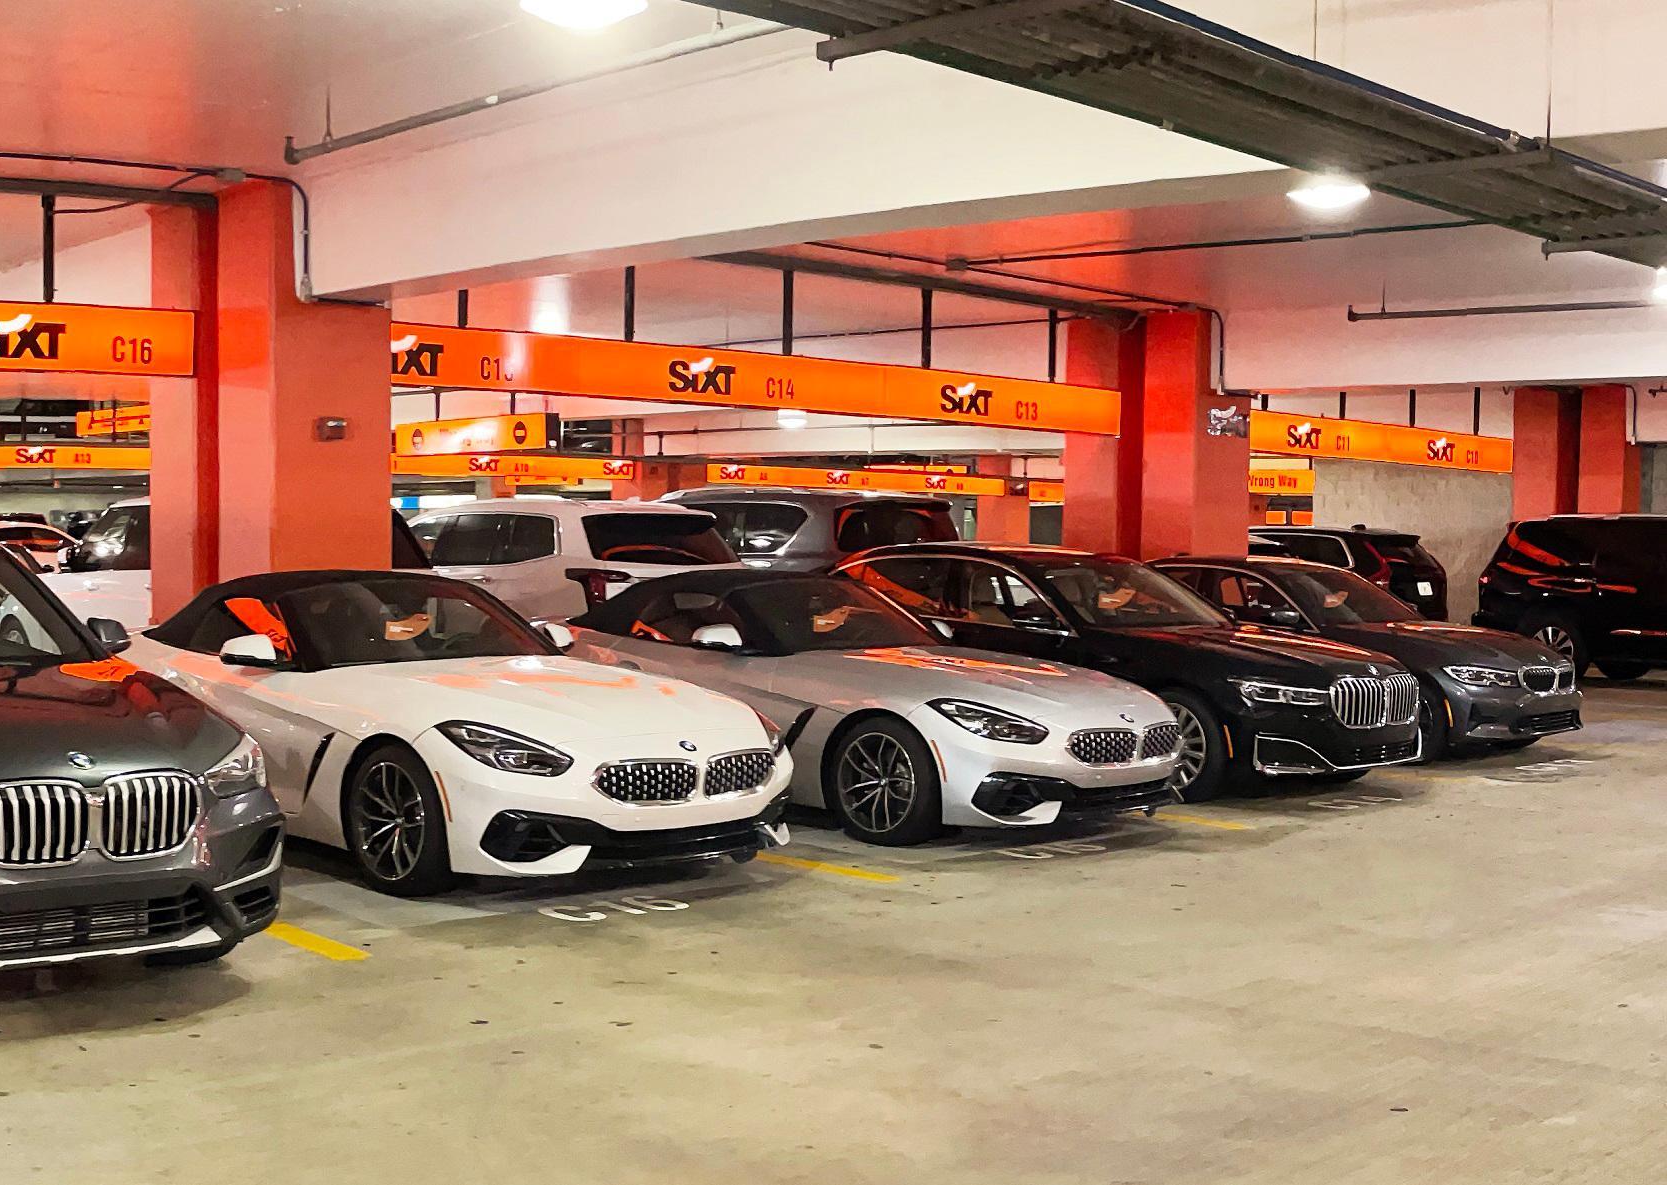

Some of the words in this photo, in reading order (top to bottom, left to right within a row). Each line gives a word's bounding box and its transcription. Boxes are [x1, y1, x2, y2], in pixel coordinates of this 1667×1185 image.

[112, 336, 153, 365] C16
[766, 377, 795, 400] C14
[1015, 400, 1038, 421] C13
[1466, 449, 1478, 465] C10
[1278, 475, 1298, 488] Way
[537, 895, 690, 922] C16
